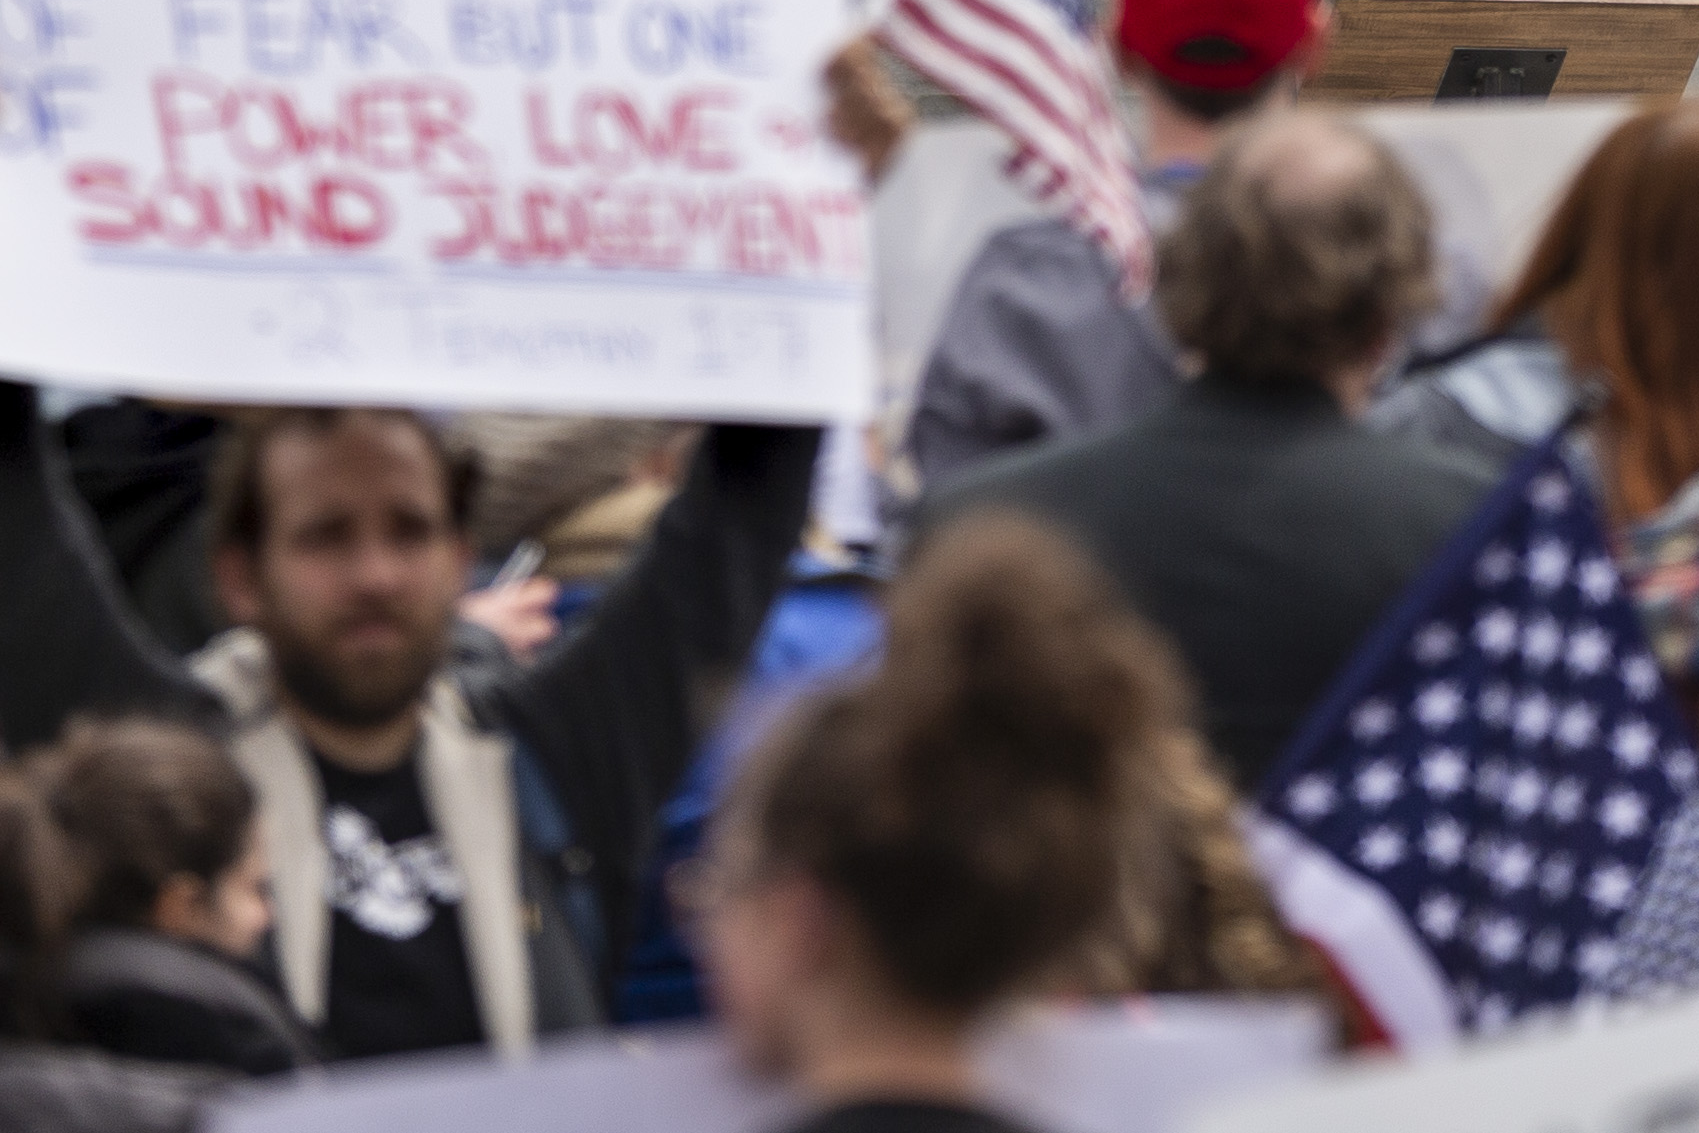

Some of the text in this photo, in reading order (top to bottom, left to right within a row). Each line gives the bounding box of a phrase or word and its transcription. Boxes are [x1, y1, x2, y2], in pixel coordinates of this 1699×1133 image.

[0, 67, 100, 156] OF
[148, 70, 488, 186] POWER
[522, 82, 742, 176] LOVE
[66, 161, 862, 275] SOUND JUDGEMENT
